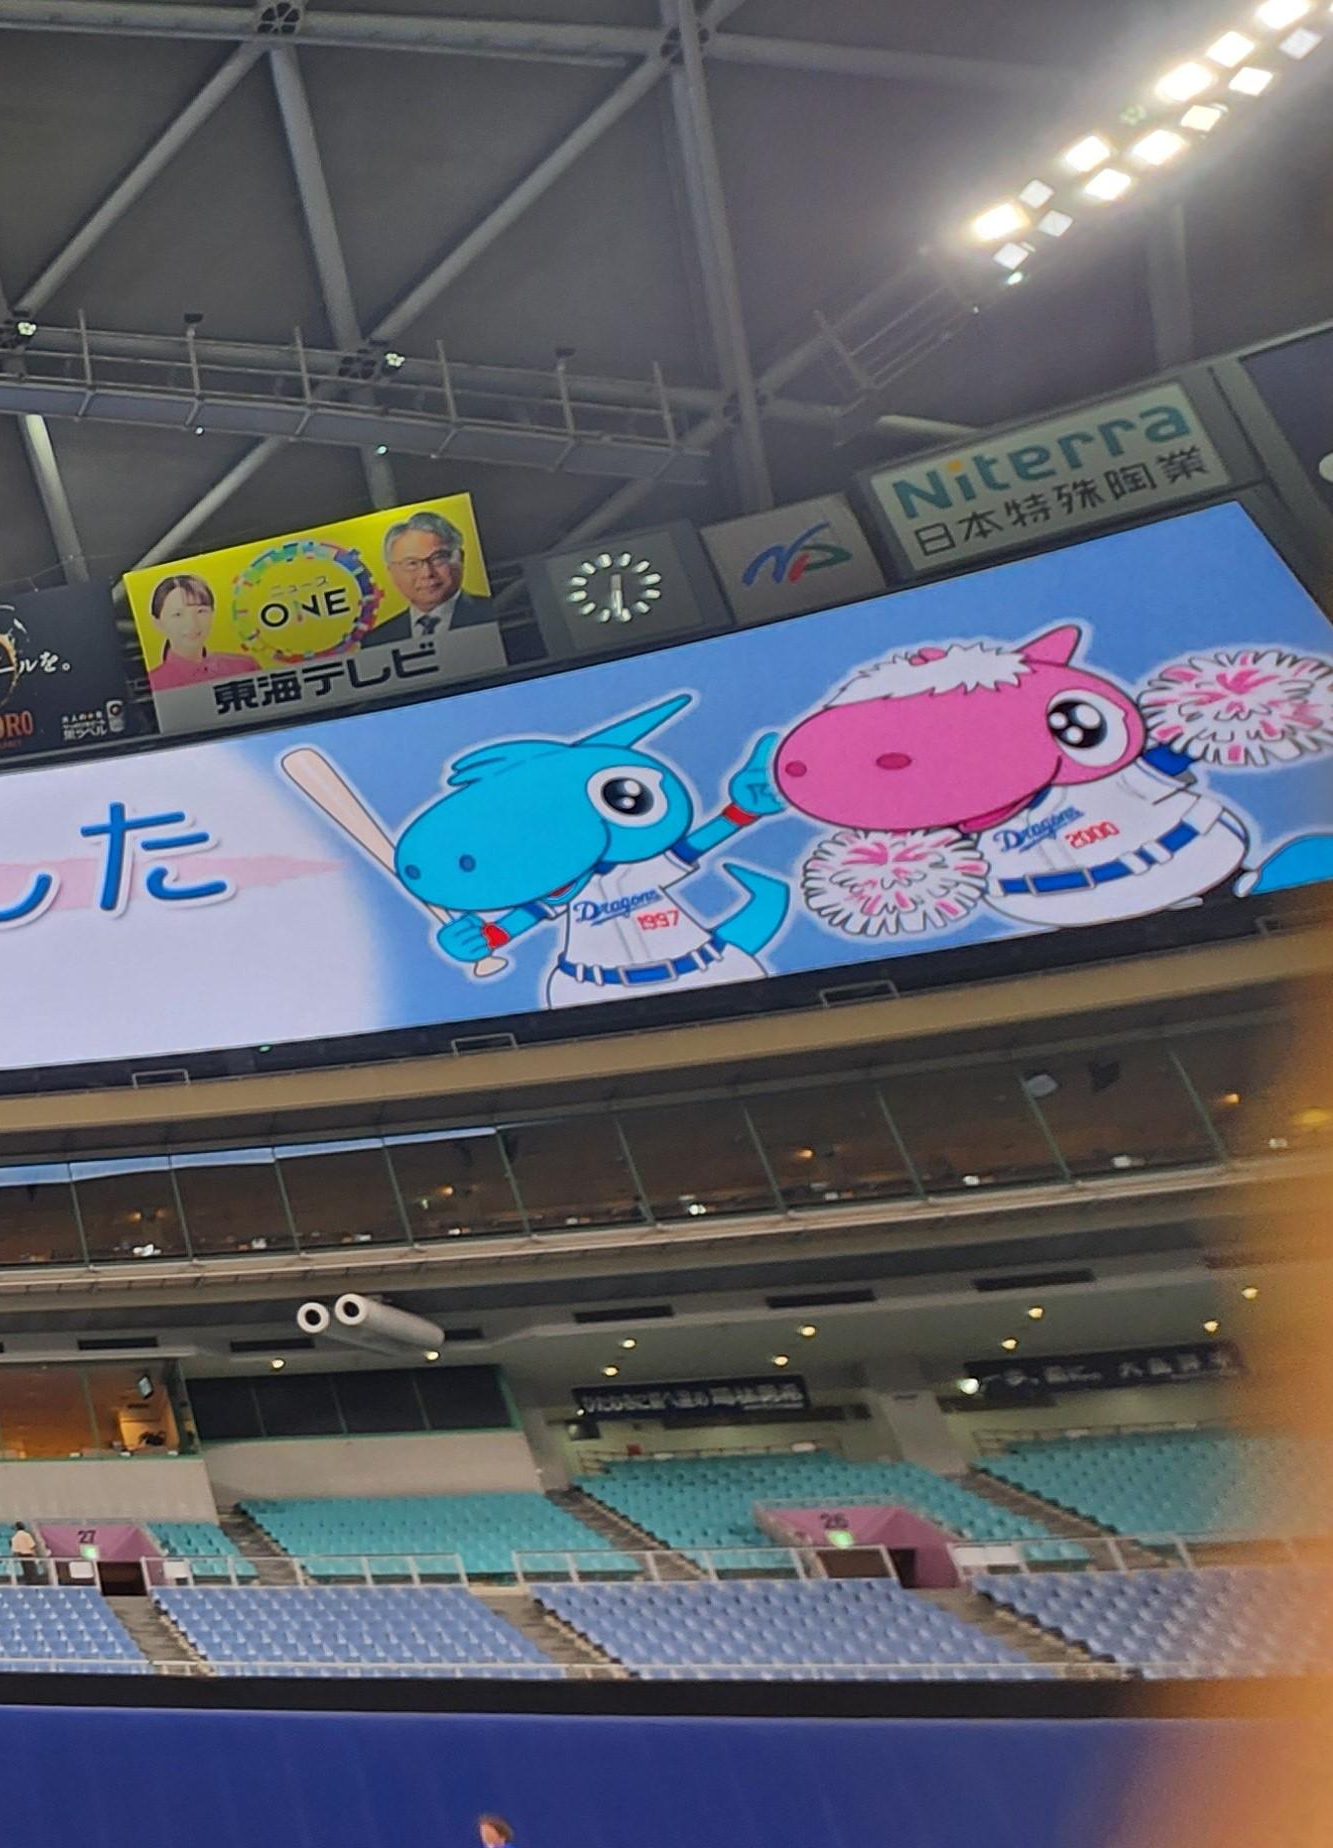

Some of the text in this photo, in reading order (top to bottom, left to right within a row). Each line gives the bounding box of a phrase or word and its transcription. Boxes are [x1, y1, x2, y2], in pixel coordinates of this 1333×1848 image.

[891, 404, 1193, 519] Niterra
[914, 446, 1209, 557] 日本特殊陶業
[270, 575, 330, 598] ニュース
[261, 588, 350, 627] ONE
[213, 641, 440, 714] 東海テレビ
[993, 805, 1085, 853] Dragons
[1065, 820, 1120, 849] 2000
[573, 888, 664, 927] Dragons
[637, 909, 679, 931] 1997
[77, 1529, 97, 1544] 27
